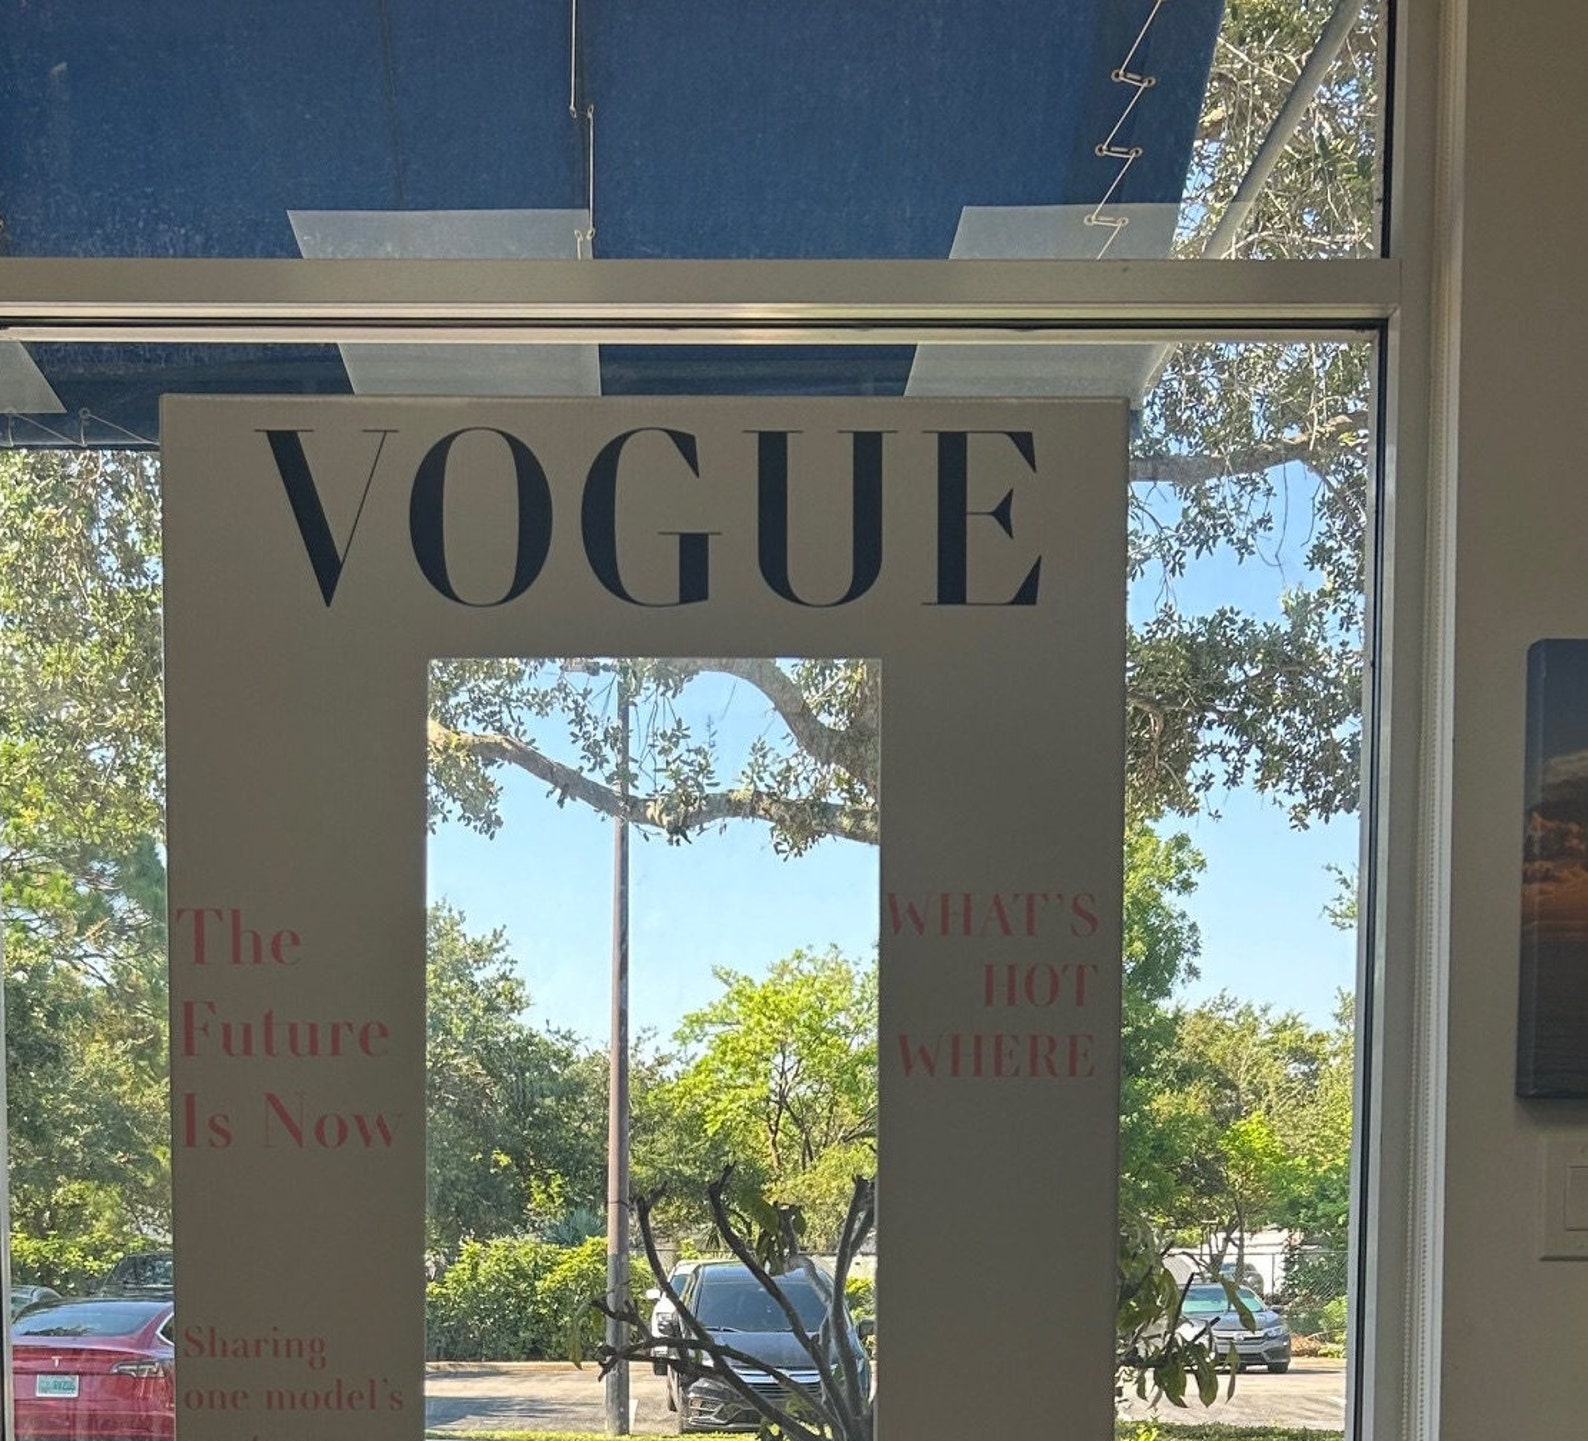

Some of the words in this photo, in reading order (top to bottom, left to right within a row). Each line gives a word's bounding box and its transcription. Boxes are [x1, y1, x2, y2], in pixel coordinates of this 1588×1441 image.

[254, 426, 1041, 608] VOGUE
[176, 907, 301, 965] The
[887, 892, 1099, 937] WHAT'S
[984, 963, 1099, 1007] HOT
[181, 1001, 391, 1057] Future
[898, 1034, 1096, 1078] WHERE
[184, 1092, 233, 1149] Is
[264, 1092, 402, 1149] Now
[184, 1325, 326, 1371] Sharing
[184, 1387, 247, 1411] one
[267, 1378, 405, 1411] model's
